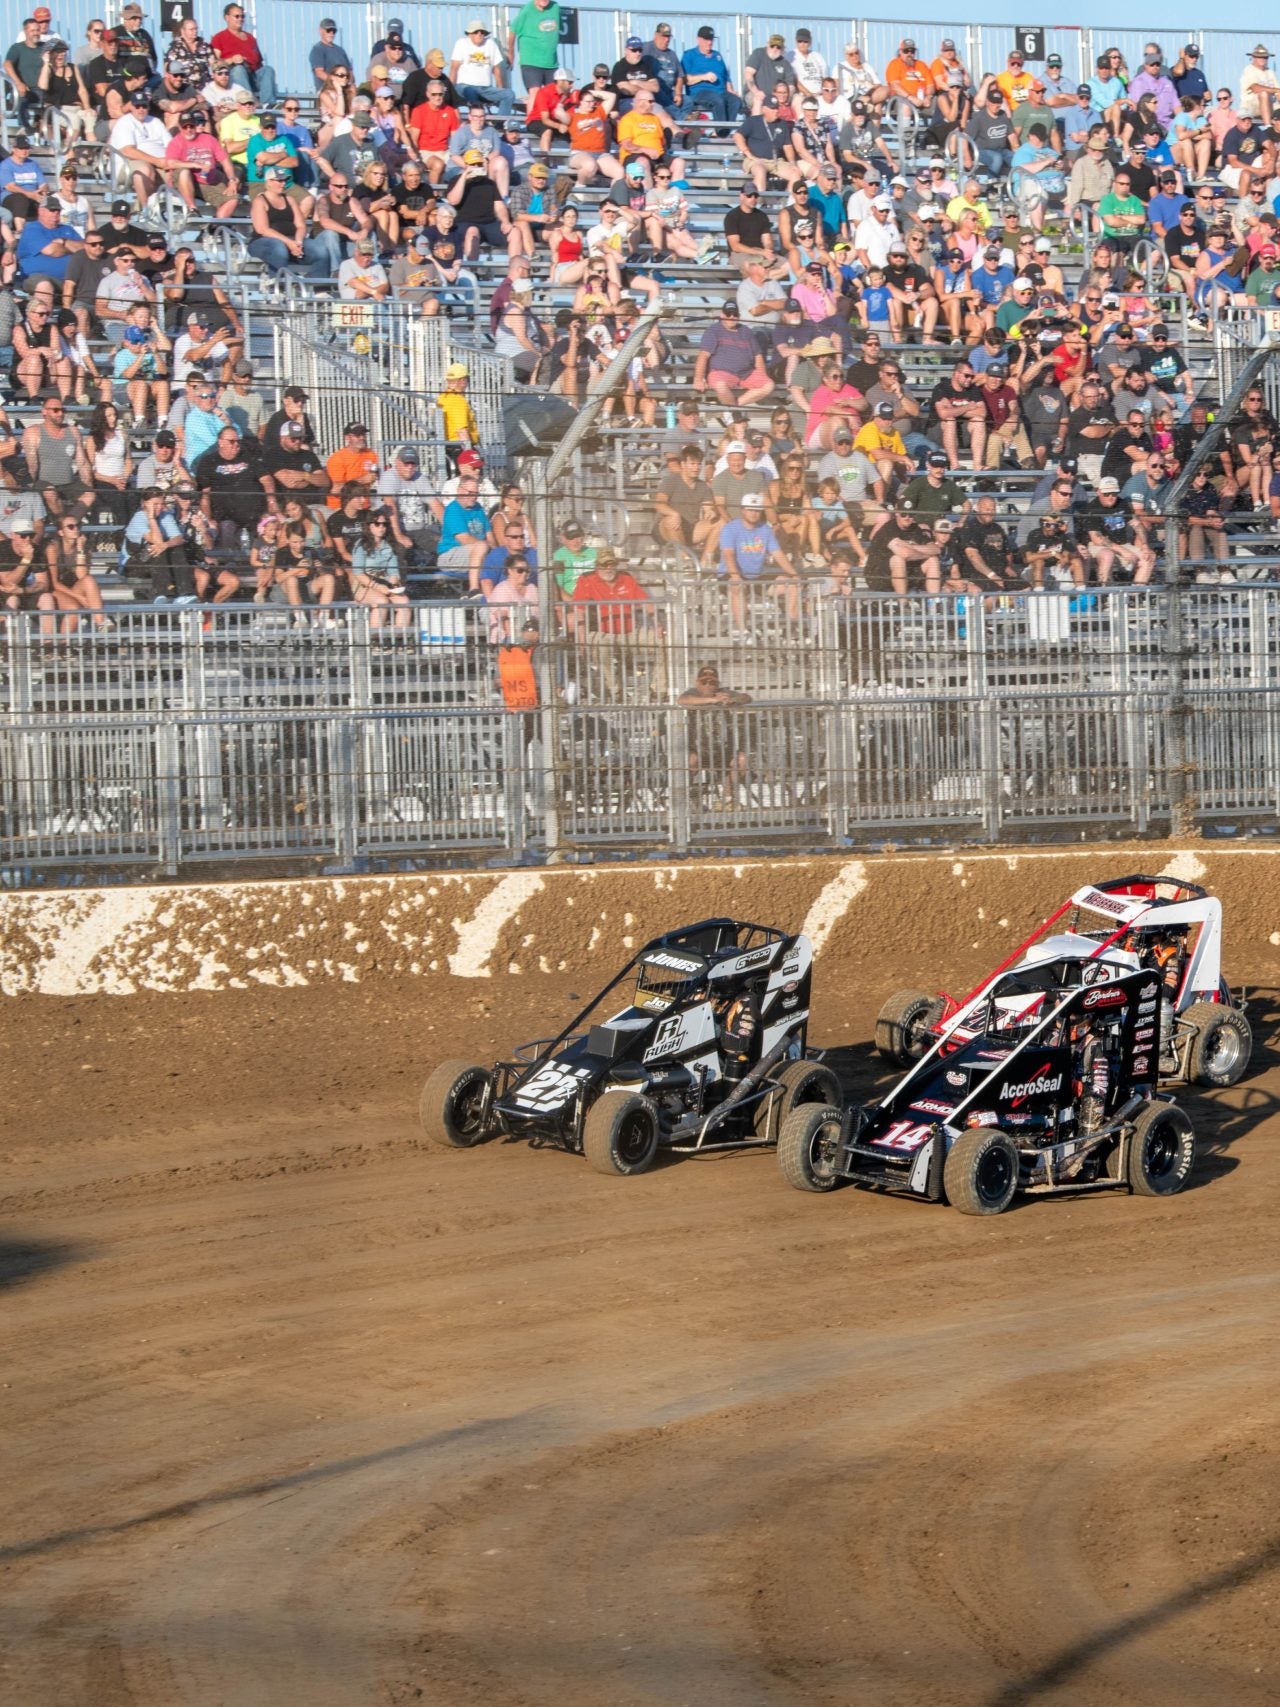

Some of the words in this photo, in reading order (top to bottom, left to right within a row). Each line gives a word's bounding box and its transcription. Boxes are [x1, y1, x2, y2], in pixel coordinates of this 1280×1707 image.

[171, 4, 183, 22] 4
[1025, 33, 1036, 53] 6
[341, 305, 364, 325] EXIT
[644, 952, 704, 973] JONES
[644, 1038, 682, 1061] RUSH
[1000, 1073, 1063, 1100] AccroSeal
[910, 1101, 953, 1113] ARMO
[871, 1120, 933, 1151] 14
[1177, 1131, 1194, 1180] Hoosier
